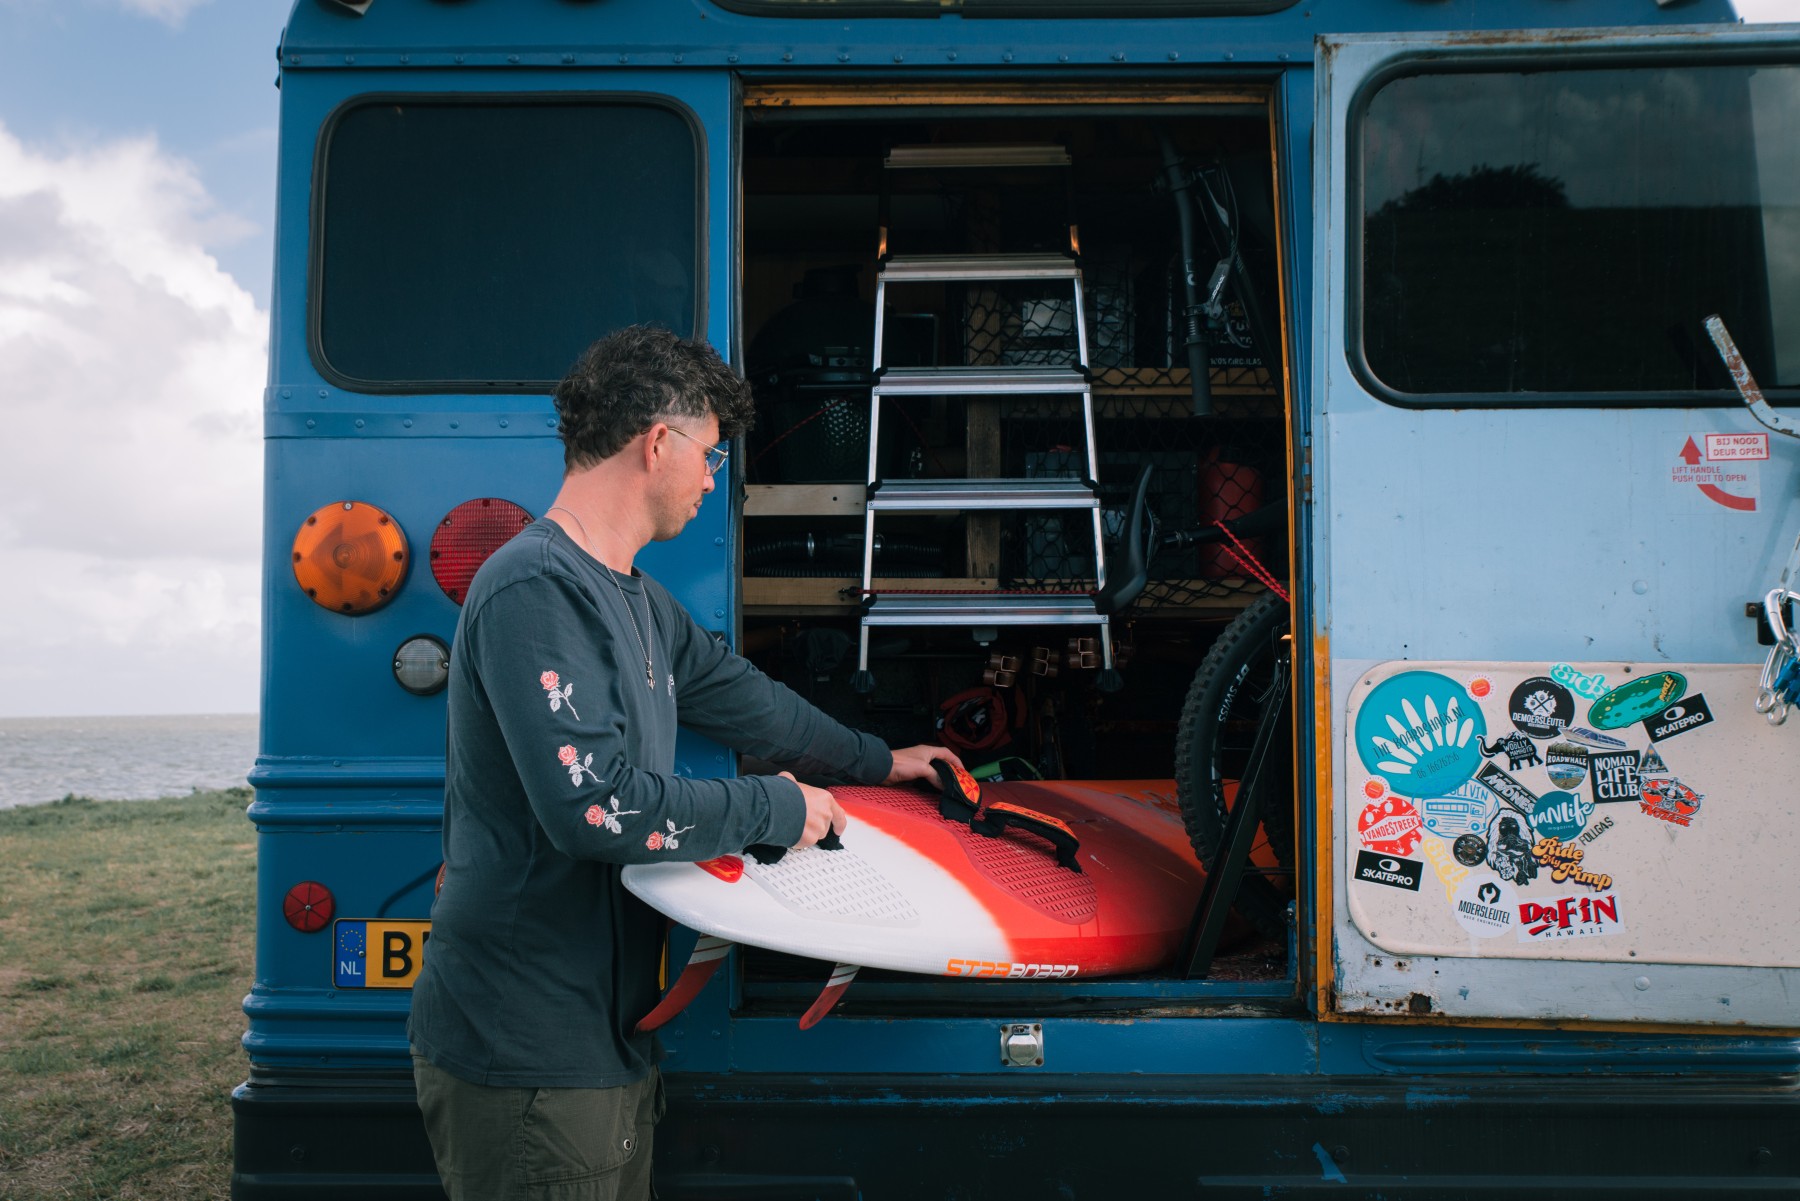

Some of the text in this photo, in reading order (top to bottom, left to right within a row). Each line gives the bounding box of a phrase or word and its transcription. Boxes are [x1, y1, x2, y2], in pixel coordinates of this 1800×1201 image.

[1716, 437, 1759, 446] BIJ NOOD
[1713, 447, 1763, 456] DEUR OPEN
[1672, 466, 1721, 474] LIFT HANDLE
[1672, 475, 1693, 483] PUSH
[1714, 474, 1724, 482] TO
[1726, 474, 1747, 482] OPEN
[1218, 685, 1238, 722] SWISS
[1512, 712, 1567, 728] DEMOERSLEUTEL
[1655, 712, 1705, 738] SKATEPRO
[1372, 743, 1392, 760] THE
[1503, 740, 1528, 752] WOOLLY
[1547, 755, 1587, 766] ROADWHALE
[1594, 755, 1635, 771] NOMAD
[1596, 766, 1637, 785] LIFE
[1598, 783, 1639, 799] CLUB
[1578, 816, 1615, 846] FOLLGAS
[1531, 836, 1584, 861] Ride
[1539, 854, 1561, 868] My
[1362, 868, 1413, 886] SKATEPRO
[1551, 861, 1612, 892] Pimp
[1458, 900, 1511, 925] MOERSLEUTEL
[1545, 927, 1603, 938] HAWAII
[340, 961, 361, 975] NL
[943, 958, 1079, 979] STARBOARD
